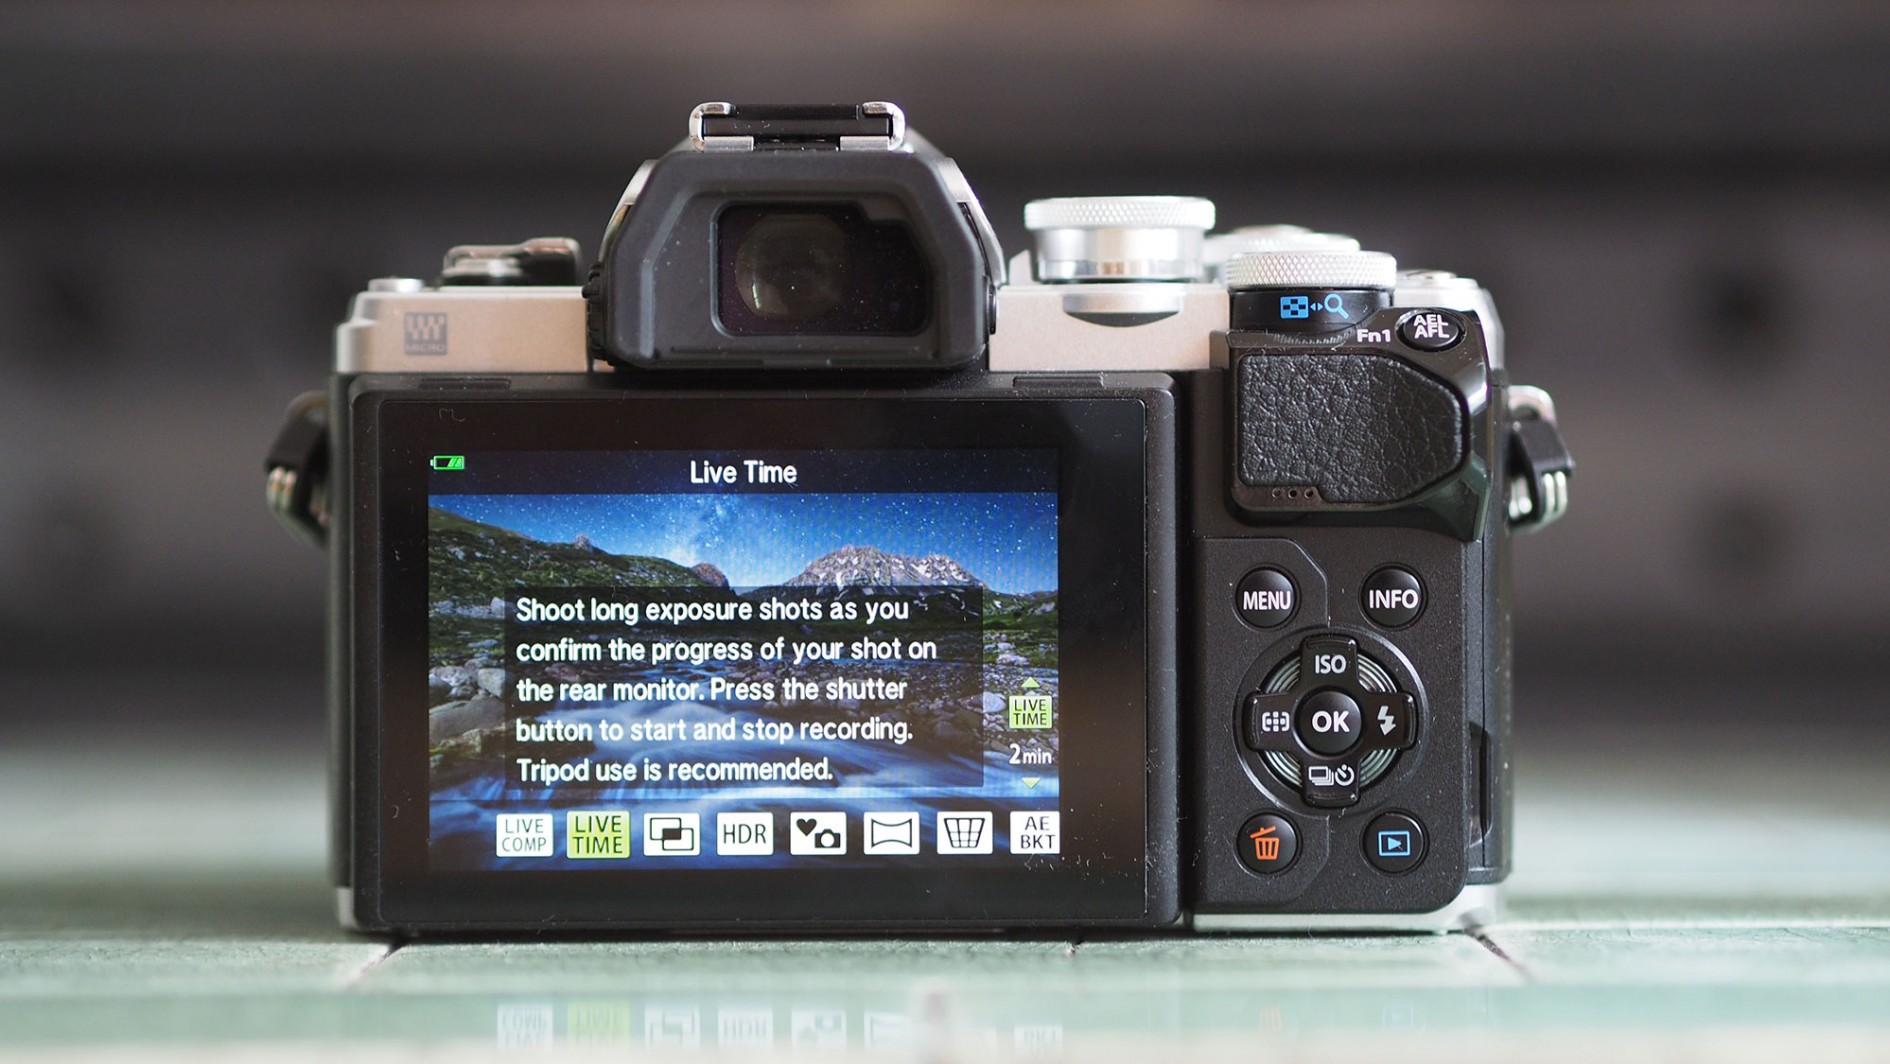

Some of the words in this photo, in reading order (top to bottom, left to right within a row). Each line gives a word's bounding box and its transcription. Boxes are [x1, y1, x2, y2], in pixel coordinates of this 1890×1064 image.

[1413, 314, 1449, 327] AEL
[1356, 328, 1391, 342] Fn1
[1414, 324, 1450, 339] AFL
[690, 460, 738, 484] Live
[743, 460, 798, 484] Time
[1243, 591, 1291, 611] MENU
[1369, 589, 1419, 610] INFO
[516, 597, 585, 621] Shoot
[590, 597, 639, 626] long
[645, 602, 752, 626] exposure
[759, 597, 823, 620] shots
[829, 601, 857, 620] as
[865, 601, 909, 625] you
[516, 637, 601, 662] confirm
[608, 637, 645, 661] the
[651, 642, 753, 665] progress
[760, 636, 785, 660] of
[792, 641, 844, 665] your
[850, 636, 902, 660] shot
[908, 641, 937, 660] on
[1314, 654, 1347, 675] ISO
[516, 678, 554, 701] the
[559, 682, 607, 701] rear
[612, 677, 705, 701] monitor.
[710, 677, 775, 700] Press
[782, 676, 819, 700] the
[826, 676, 908, 700] shutter
[1014, 699, 1047, 712] LIVE
[1013, 713, 1048, 726] TIME
[1311, 711, 1350, 733] OK
[516, 717, 593, 742] button
[599, 719, 624, 741] to
[630, 719, 687, 741] start
[693, 717, 736, 741] and
[742, 718, 794, 744] stop
[800, 716, 913, 744] recording.
[1009, 743, 1053, 765] 2min
[516, 758, 590, 786] Tripod
[595, 763, 637, 782] use
[643, 757, 662, 782] is
[668, 756, 833, 781] recommended.
[505, 818, 545, 834] LIVE
[574, 815, 622, 834] LIVE
[1024, 816, 1050, 831] AE
[501, 836, 547, 852] COMP
[722, 823, 767, 845] HDR
[1020, 834, 1056, 850] BKT
[572, 836, 623, 854] TIME
